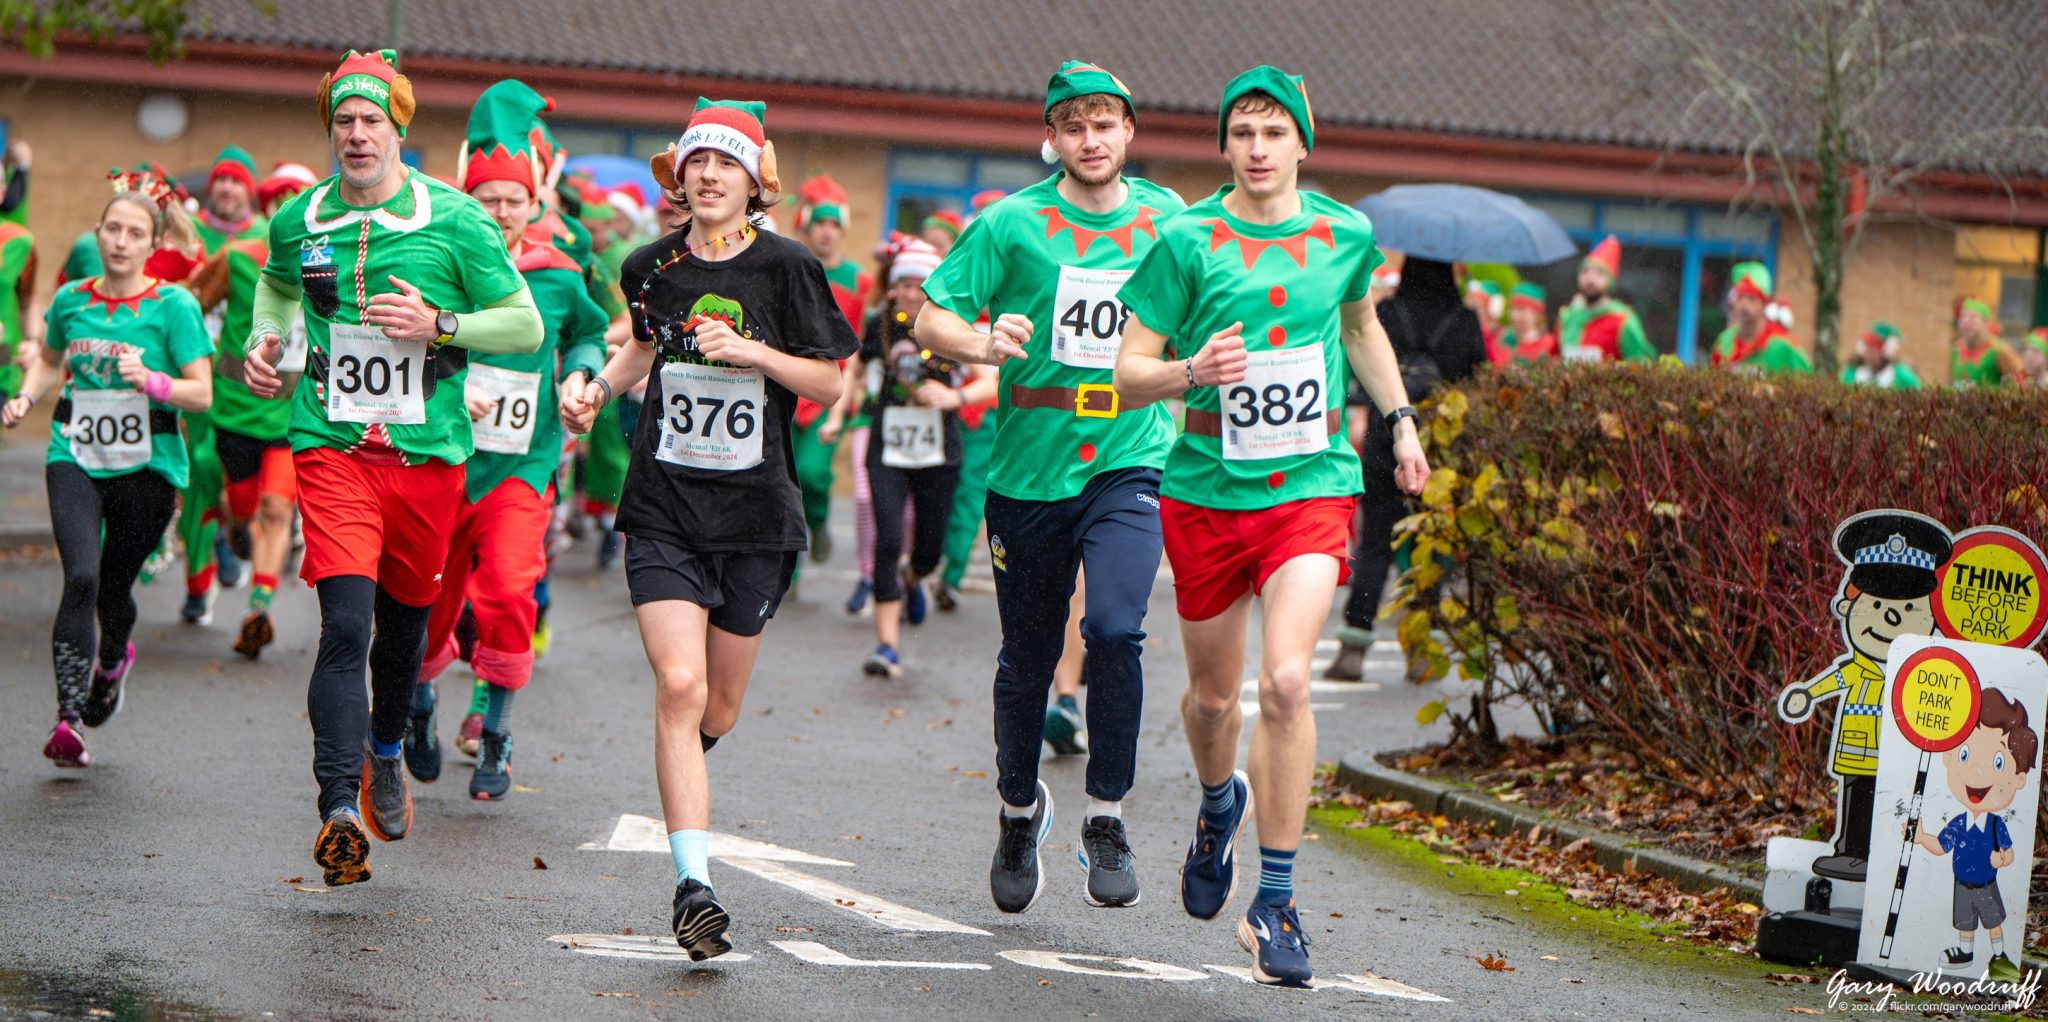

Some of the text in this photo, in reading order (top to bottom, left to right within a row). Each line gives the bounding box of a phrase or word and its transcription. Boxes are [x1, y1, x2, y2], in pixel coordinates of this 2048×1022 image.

[354, 76, 389, 100] Helper
[336, 354, 410, 396] 301
[685, 373, 707, 382] Bristol
[472, 396, 530, 430] 19
[1228, 378, 1322, 428] 382
[671, 393, 755, 439] 376
[76, 413, 143, 445] 308
[888, 425, 936, 449] 374
[685, 442, 708, 451] Mental
[689, 450, 721, 460] December
[1136, 493, 1160, 509] Kapp
[1953, 563, 2034, 597] THINK
[1951, 586, 2028, 612] BEFORE
[1968, 604, 2007, 624] YOU
[1961, 618, 2010, 640] PARK
[1917, 669, 1961, 691] DON'T
[1919, 691, 1953, 711] PARK
[1916, 711, 1950, 731] HERE
